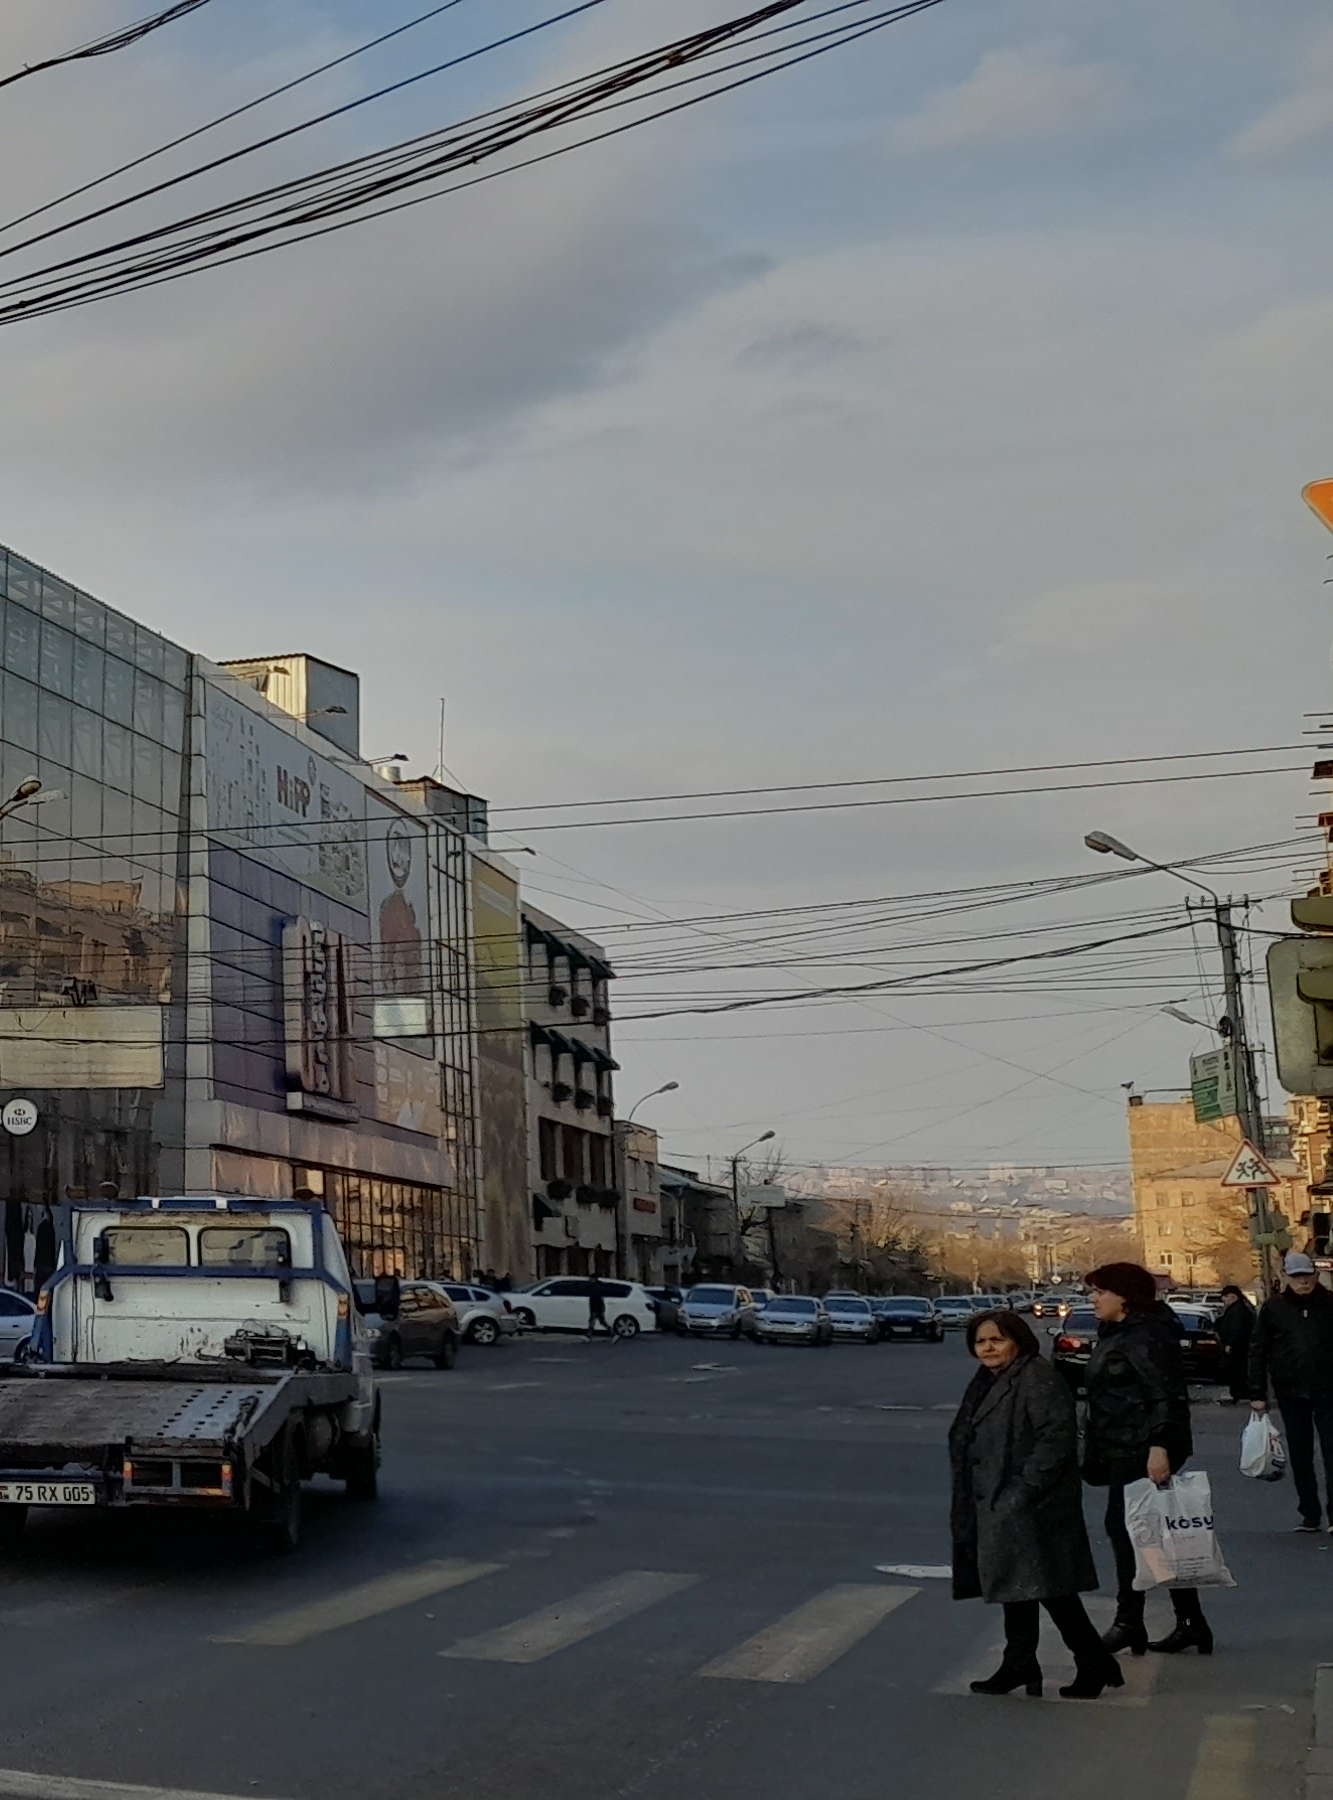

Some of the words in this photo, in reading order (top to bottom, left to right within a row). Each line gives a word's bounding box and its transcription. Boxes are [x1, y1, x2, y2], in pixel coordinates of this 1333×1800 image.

[277, 765, 311, 818] HiPP
[16, 1486, 33, 1500] 75
[38, 1486, 58, 1501] RX
[63, 1486, 90, 1502] 005
